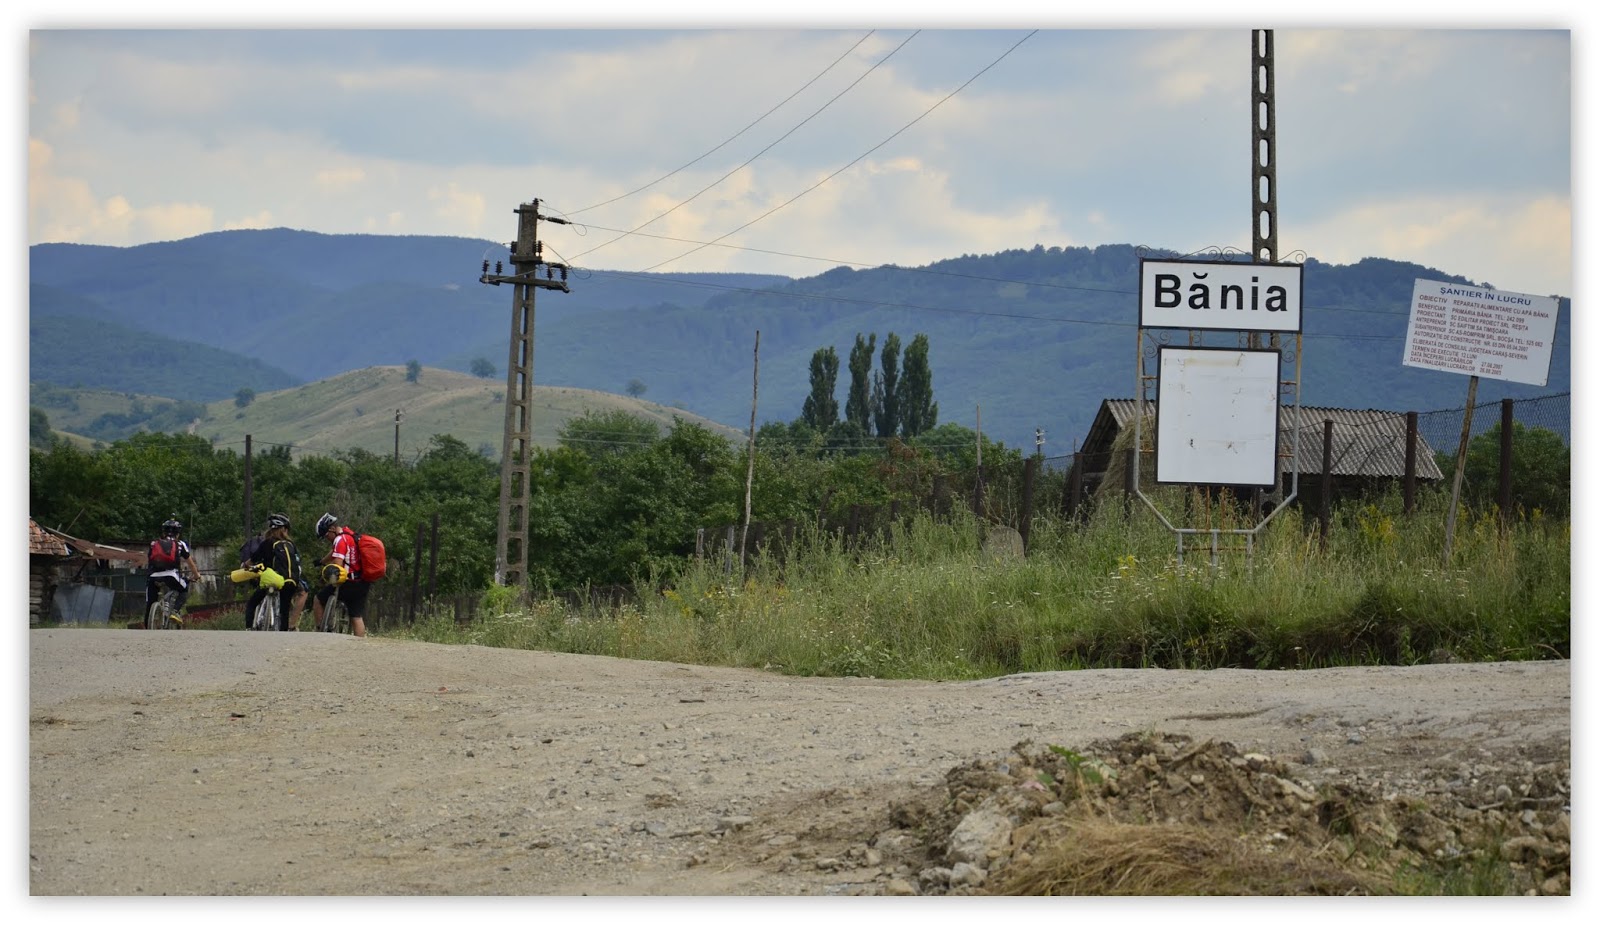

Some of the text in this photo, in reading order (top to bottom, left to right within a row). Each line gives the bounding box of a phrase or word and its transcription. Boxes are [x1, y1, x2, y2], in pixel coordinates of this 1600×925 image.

[1155, 272, 1287, 312] Bănia
[1420, 294, 1448, 303] OBIECTIV
[1480, 304, 1512, 313] ALIMENTARE
[1485, 292, 1494, 300] ÎN
[1498, 296, 1531, 306] LUCRU
[1418, 303, 1446, 311] BENEFICIAR
[1416, 317, 1446, 325] ANTREPRENOR
[1480, 318, 1499, 326] PROIECT
